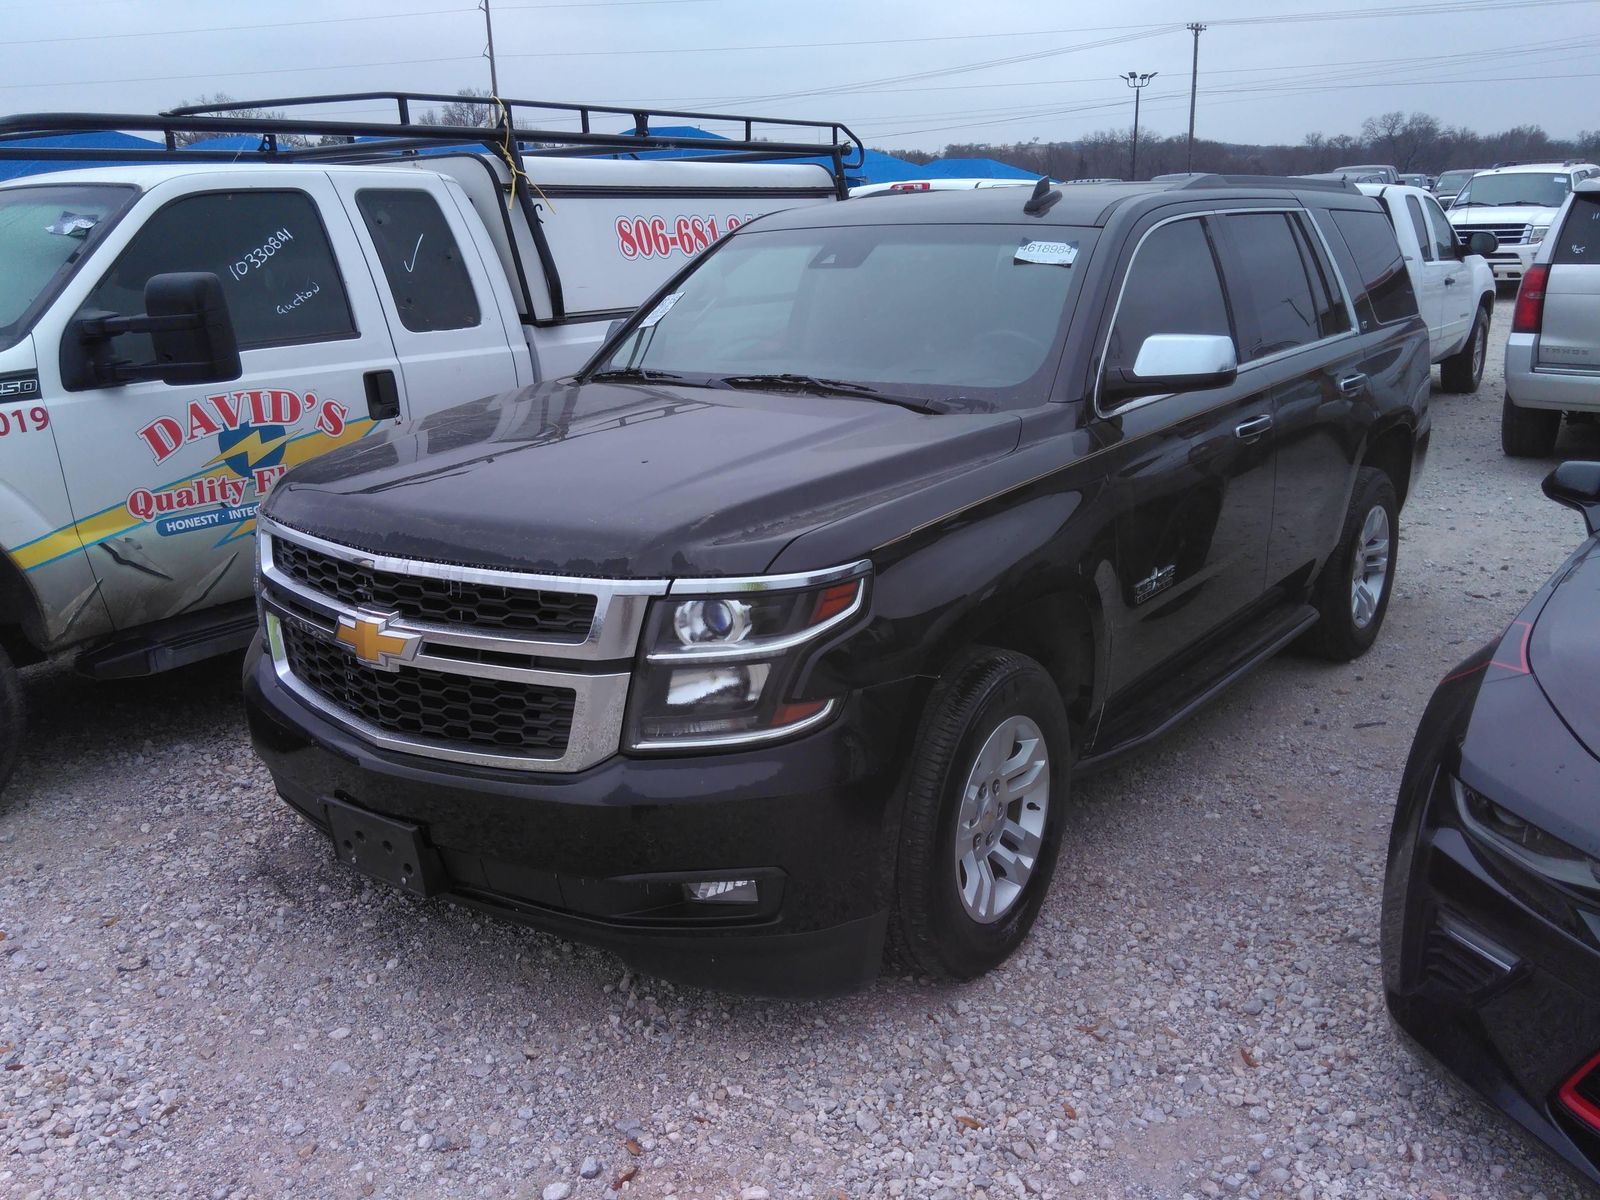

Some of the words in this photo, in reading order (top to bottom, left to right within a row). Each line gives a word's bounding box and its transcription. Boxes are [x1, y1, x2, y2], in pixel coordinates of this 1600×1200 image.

[616, 214, 753, 261] 806-681
[0, 379, 38, 396] 50
[129, 476, 247, 518] Quality
[253, 465, 287, 496] F
[166, 513, 219, 532] HONESTY
